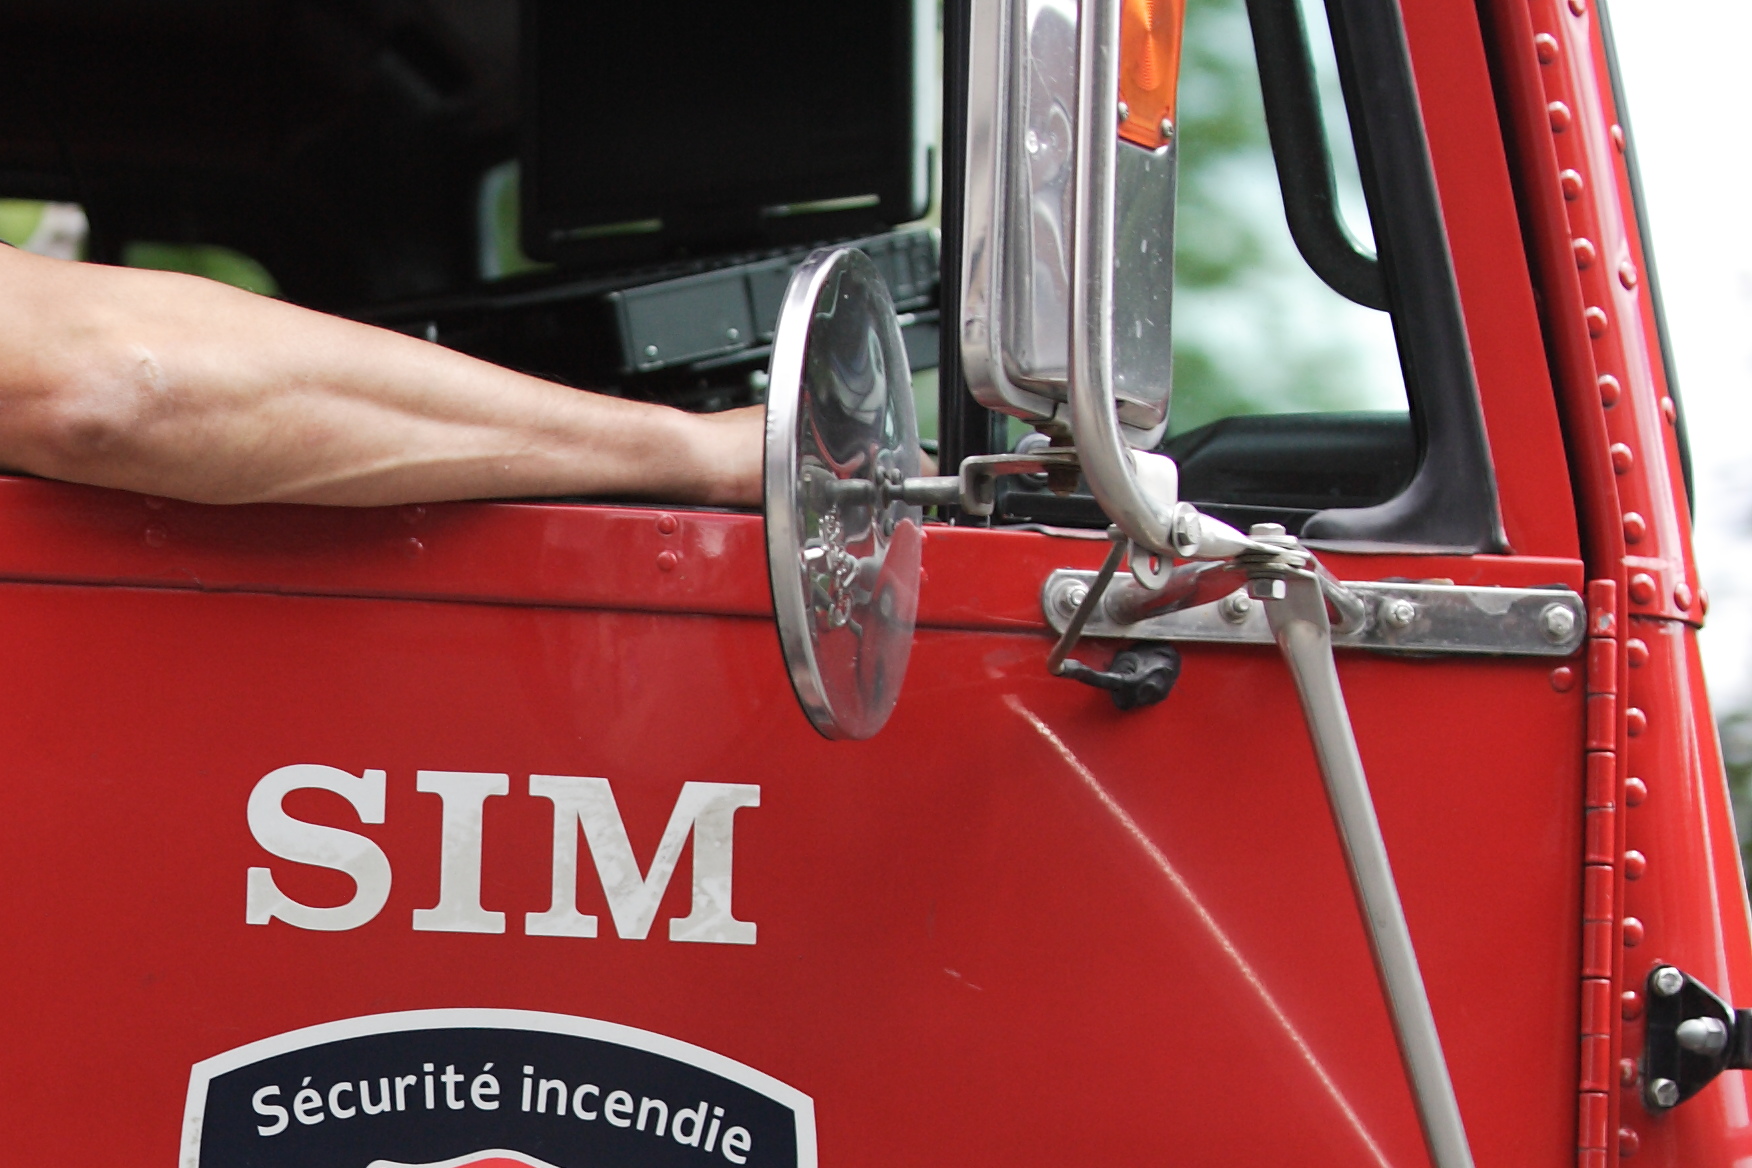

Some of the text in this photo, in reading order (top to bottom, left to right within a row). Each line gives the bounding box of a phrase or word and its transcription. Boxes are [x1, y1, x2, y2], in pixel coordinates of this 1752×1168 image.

[246, 764, 760, 944] SIM
[251, 1062, 752, 1165] Sécurité incendie
